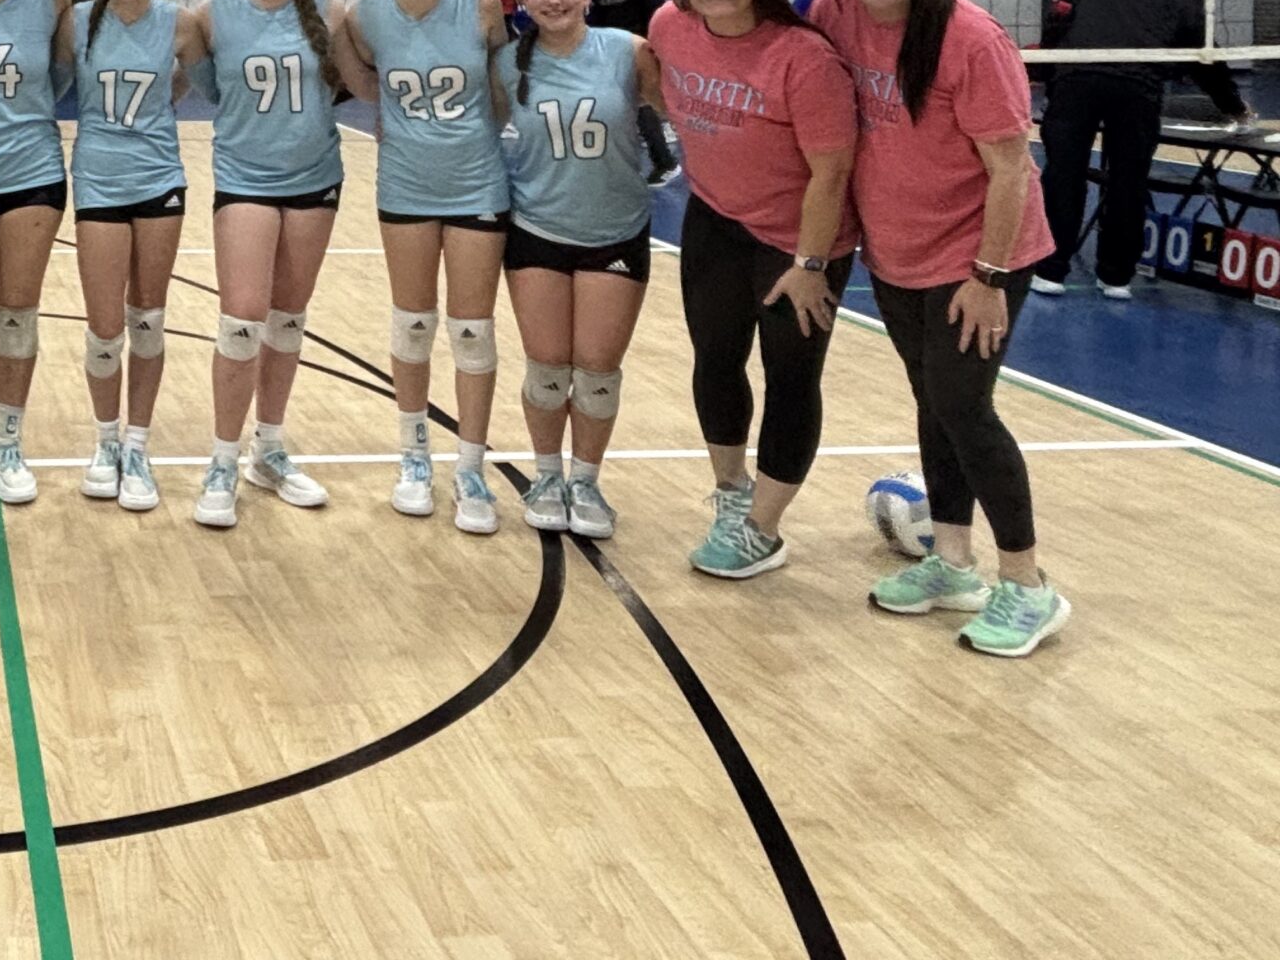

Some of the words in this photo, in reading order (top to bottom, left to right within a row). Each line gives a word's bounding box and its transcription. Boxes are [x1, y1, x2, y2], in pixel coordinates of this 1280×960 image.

[97, 69, 158, 128] 17
[242, 53, 304, 114] 91
[386, 65, 468, 121] 22
[535, 97, 608, 160] 16
[1203, 232, 1214, 251] 1
